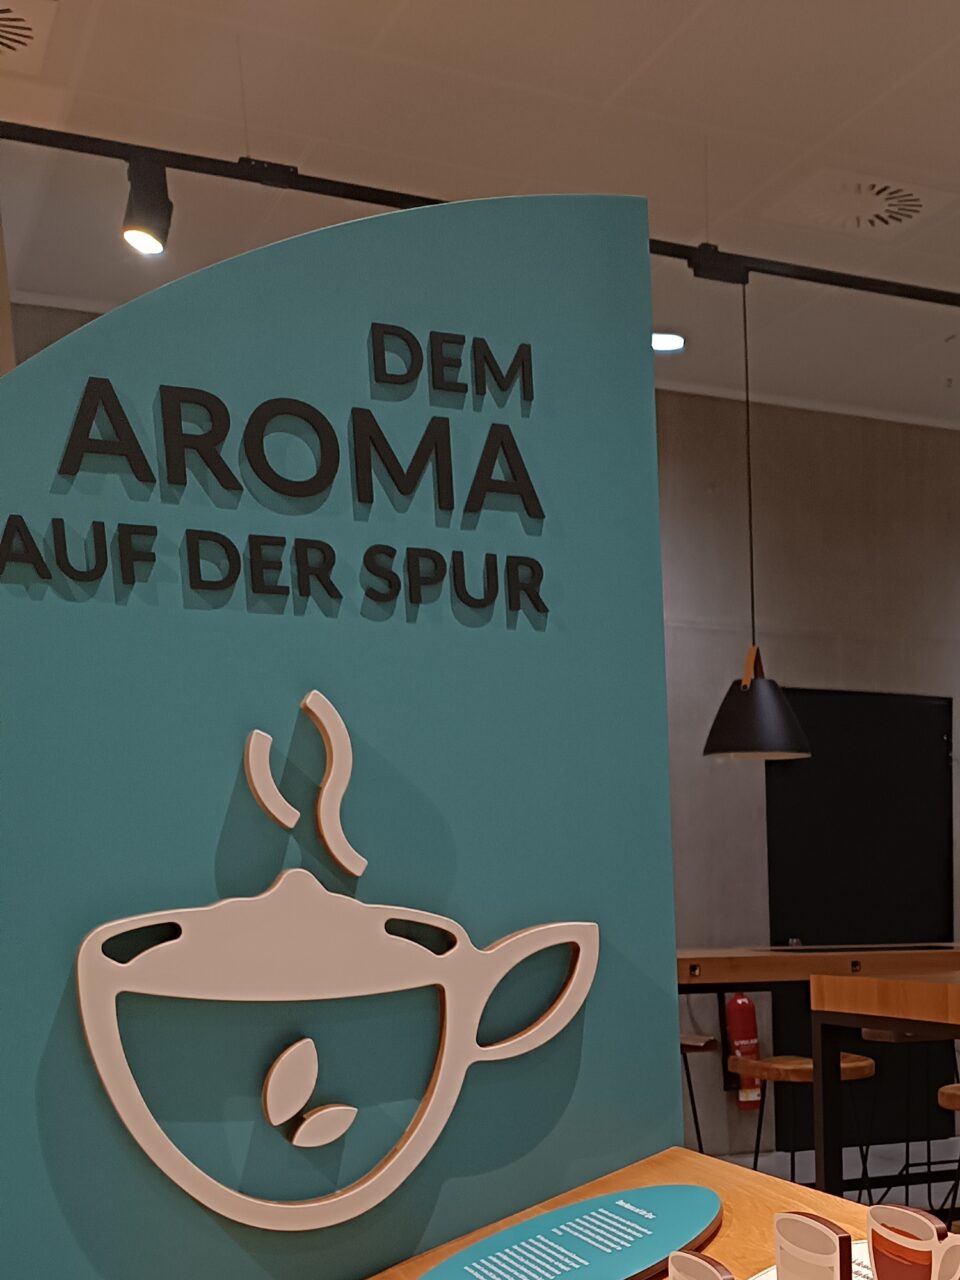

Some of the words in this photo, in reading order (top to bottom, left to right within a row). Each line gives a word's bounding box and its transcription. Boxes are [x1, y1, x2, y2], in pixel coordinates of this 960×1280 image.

[369, 322, 534, 401] DEM
[57, 376, 546, 520] AROMA
[0, 513, 158, 585] AUF
[185, 528, 343, 600] DER
[362, 543, 549, 614] SPUR
